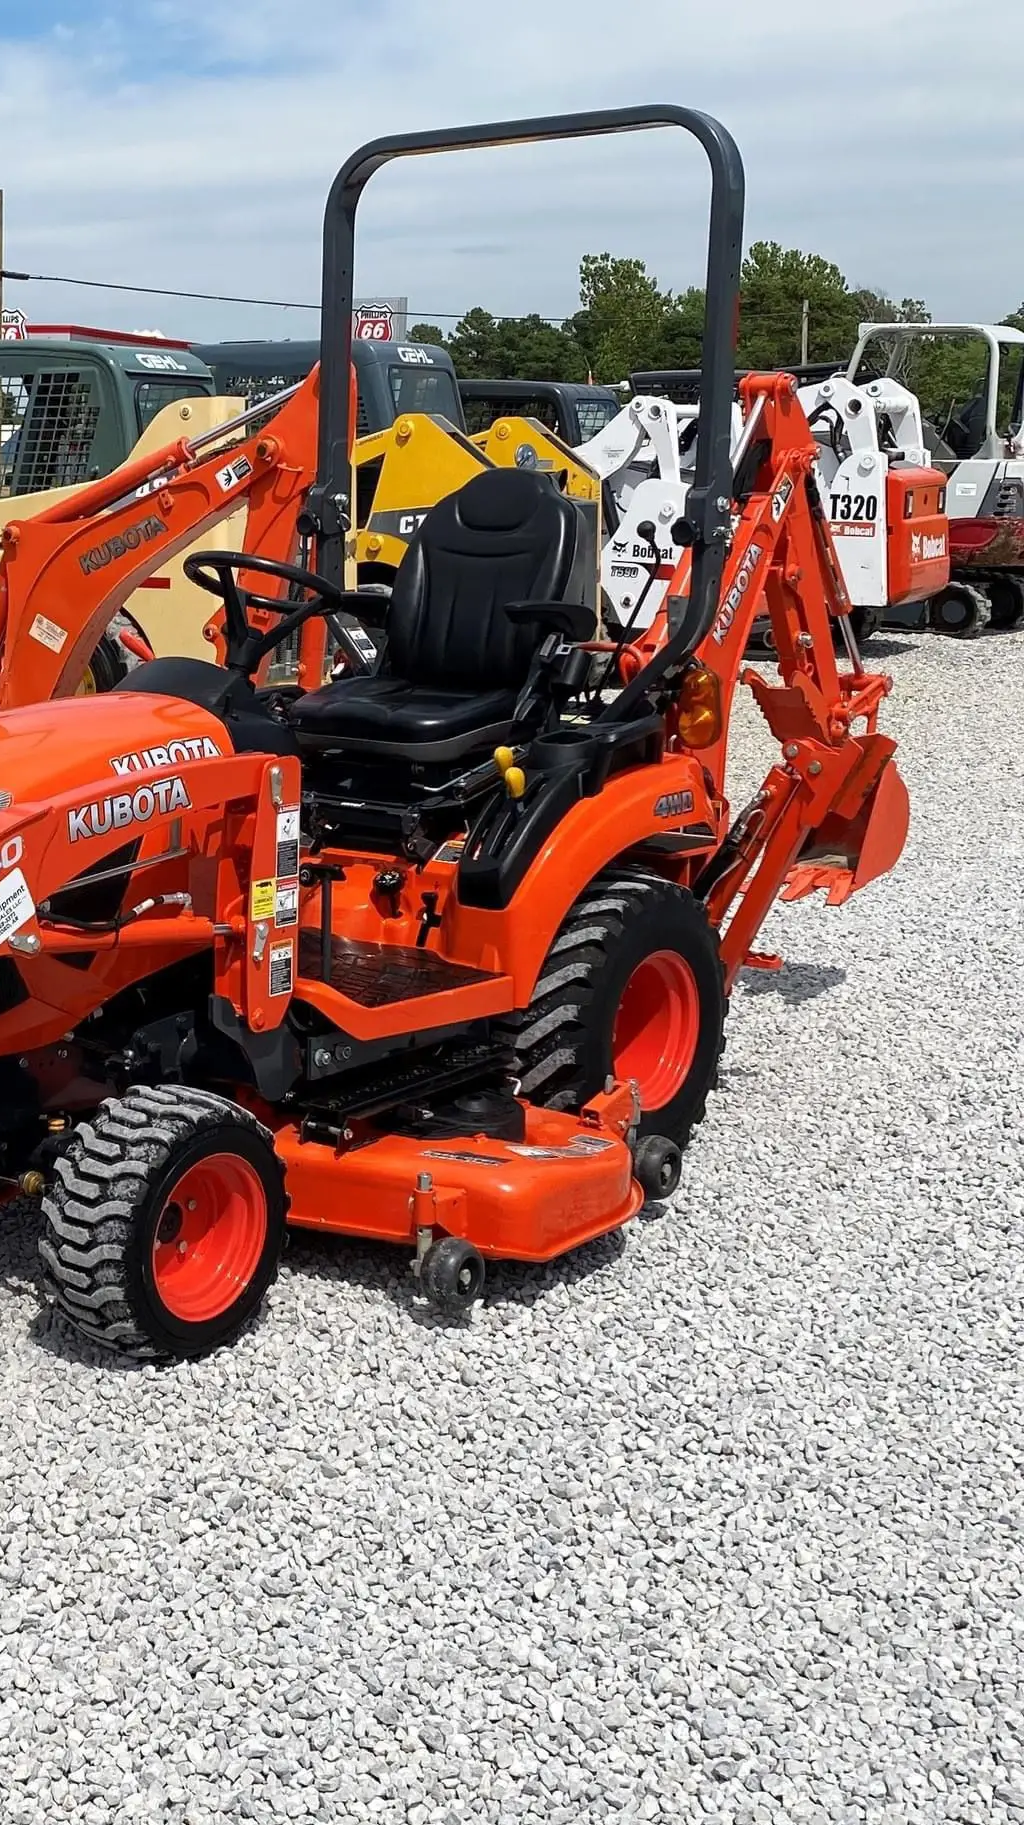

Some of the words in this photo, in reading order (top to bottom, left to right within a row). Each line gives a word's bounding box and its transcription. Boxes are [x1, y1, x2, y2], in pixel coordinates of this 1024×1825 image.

[361, 322, 386, 339] 66
[135, 353, 187, 371] GEHL
[397, 347, 434, 364] GEHL
[829, 494, 877, 521] T320
[843, 526, 874, 536] Bobcat
[79, 514, 169, 575] KUBOTA
[611, 565, 639, 578] T590
[712, 543, 764, 646] KUBOTA
[67, 776, 191, 844] KUBOTA
